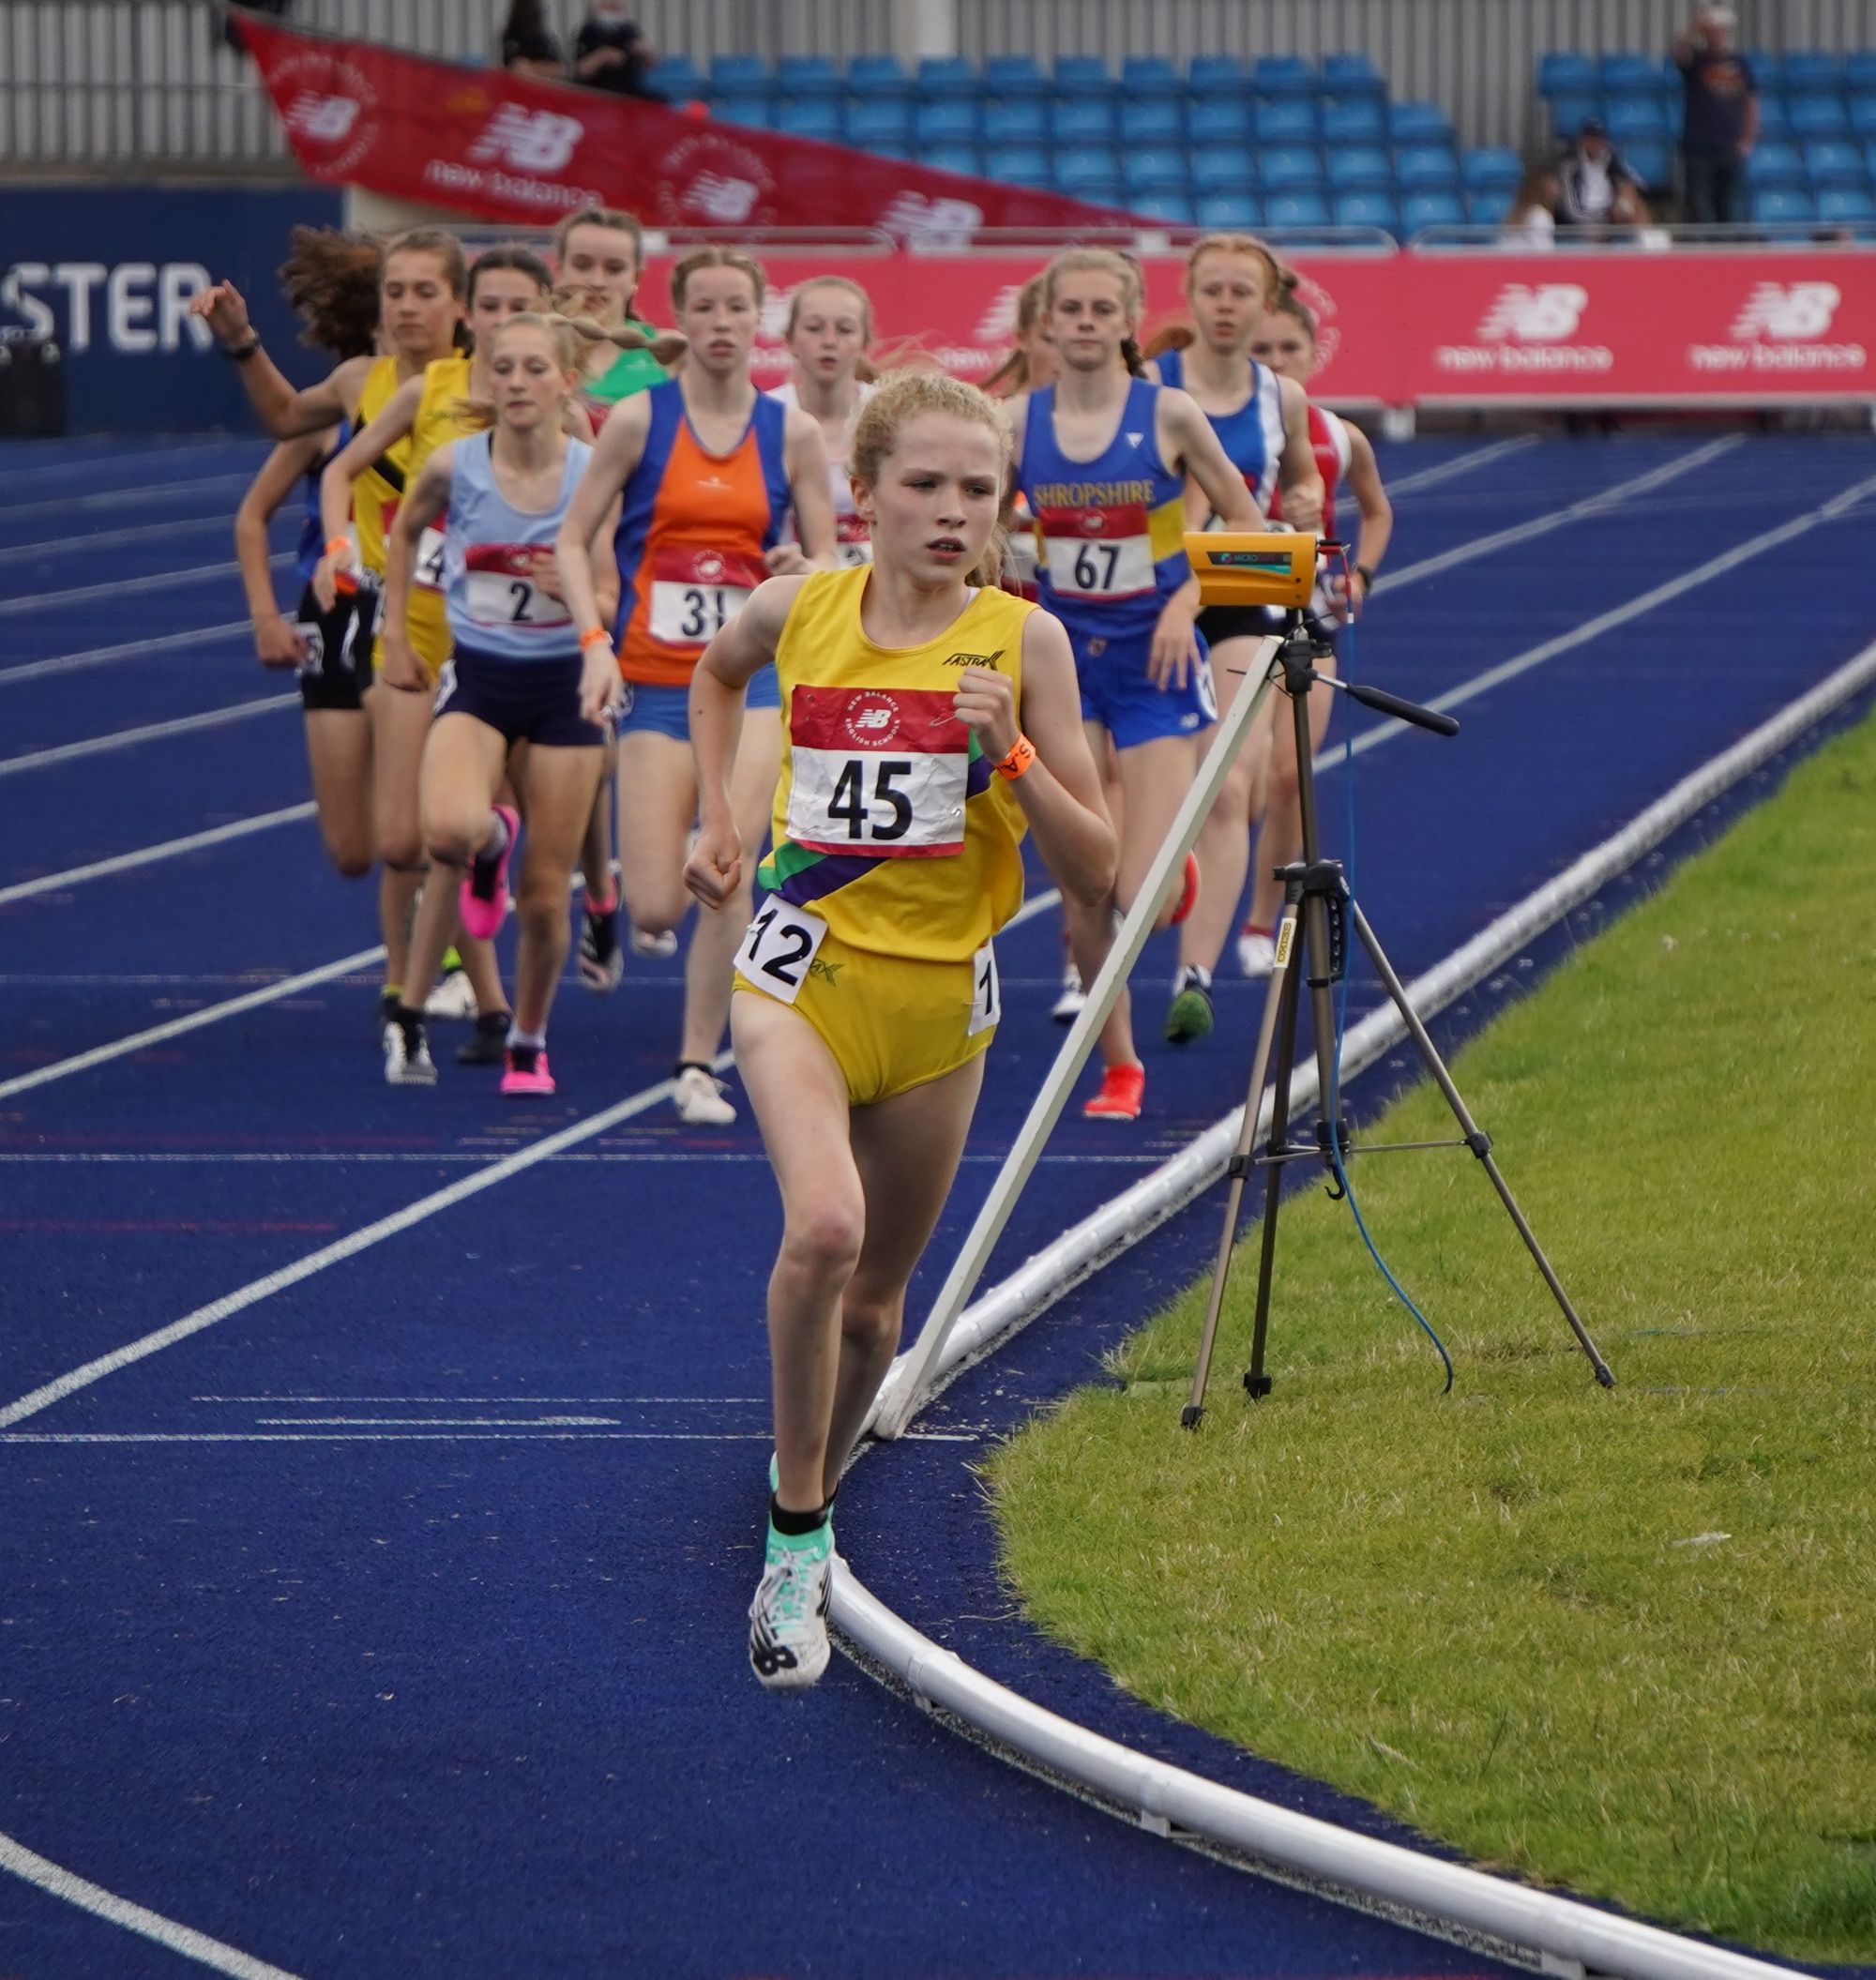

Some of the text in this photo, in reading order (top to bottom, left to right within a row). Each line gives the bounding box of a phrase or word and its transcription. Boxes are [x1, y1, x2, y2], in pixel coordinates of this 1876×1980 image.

[466, 100, 584, 170] NB
[424, 159, 605, 207] new balance
[1475, 283, 1589, 340] NB
[1727, 280, 1841, 340] NB
[1434, 343, 1614, 371] new balance
[1687, 341, 1868, 370] new balance
[1034, 479, 1155, 507] SHROPSHIRE
[1075, 542, 1121, 590] 67
[510, 582, 532, 622] 2
[847, 691, 899, 713] NEW BALANCE
[855, 708, 892, 728] NB
[845, 718, 900, 747] ENGLISH SCHOOLS
[828, 760, 913, 840] 45
[749, 908, 813, 987] 12
[1277, 922, 1292, 962] SEIKO
[979, 960, 992, 1016] 1
